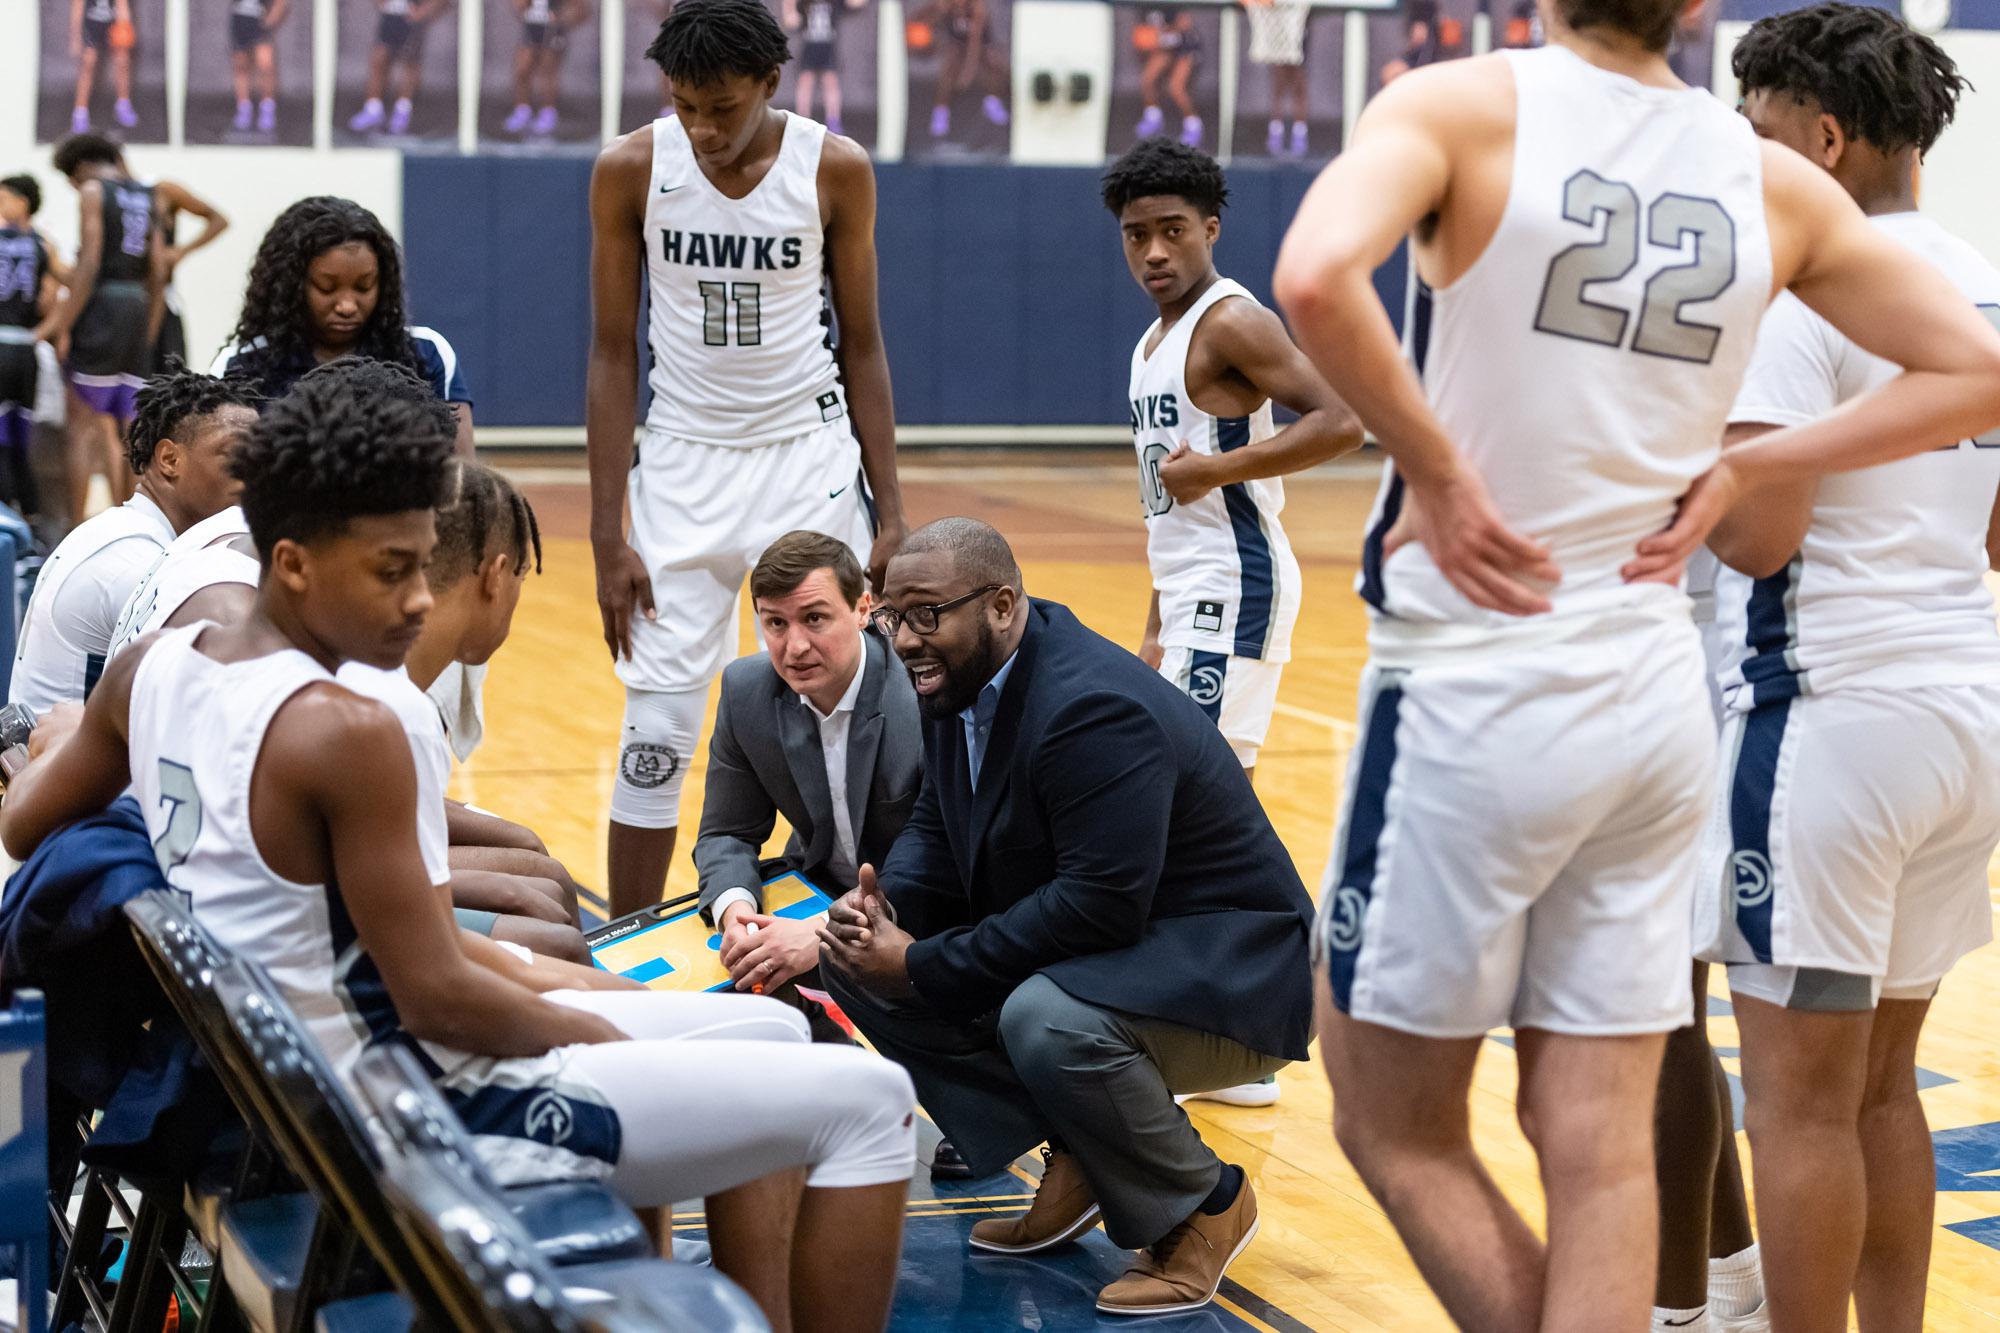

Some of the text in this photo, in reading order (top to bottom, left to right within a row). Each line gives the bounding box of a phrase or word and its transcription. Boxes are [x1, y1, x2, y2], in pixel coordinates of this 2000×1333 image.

[661, 228, 802, 270] HAWKS
[1533, 168, 1736, 365] 22
[698, 280, 761, 346] 11
